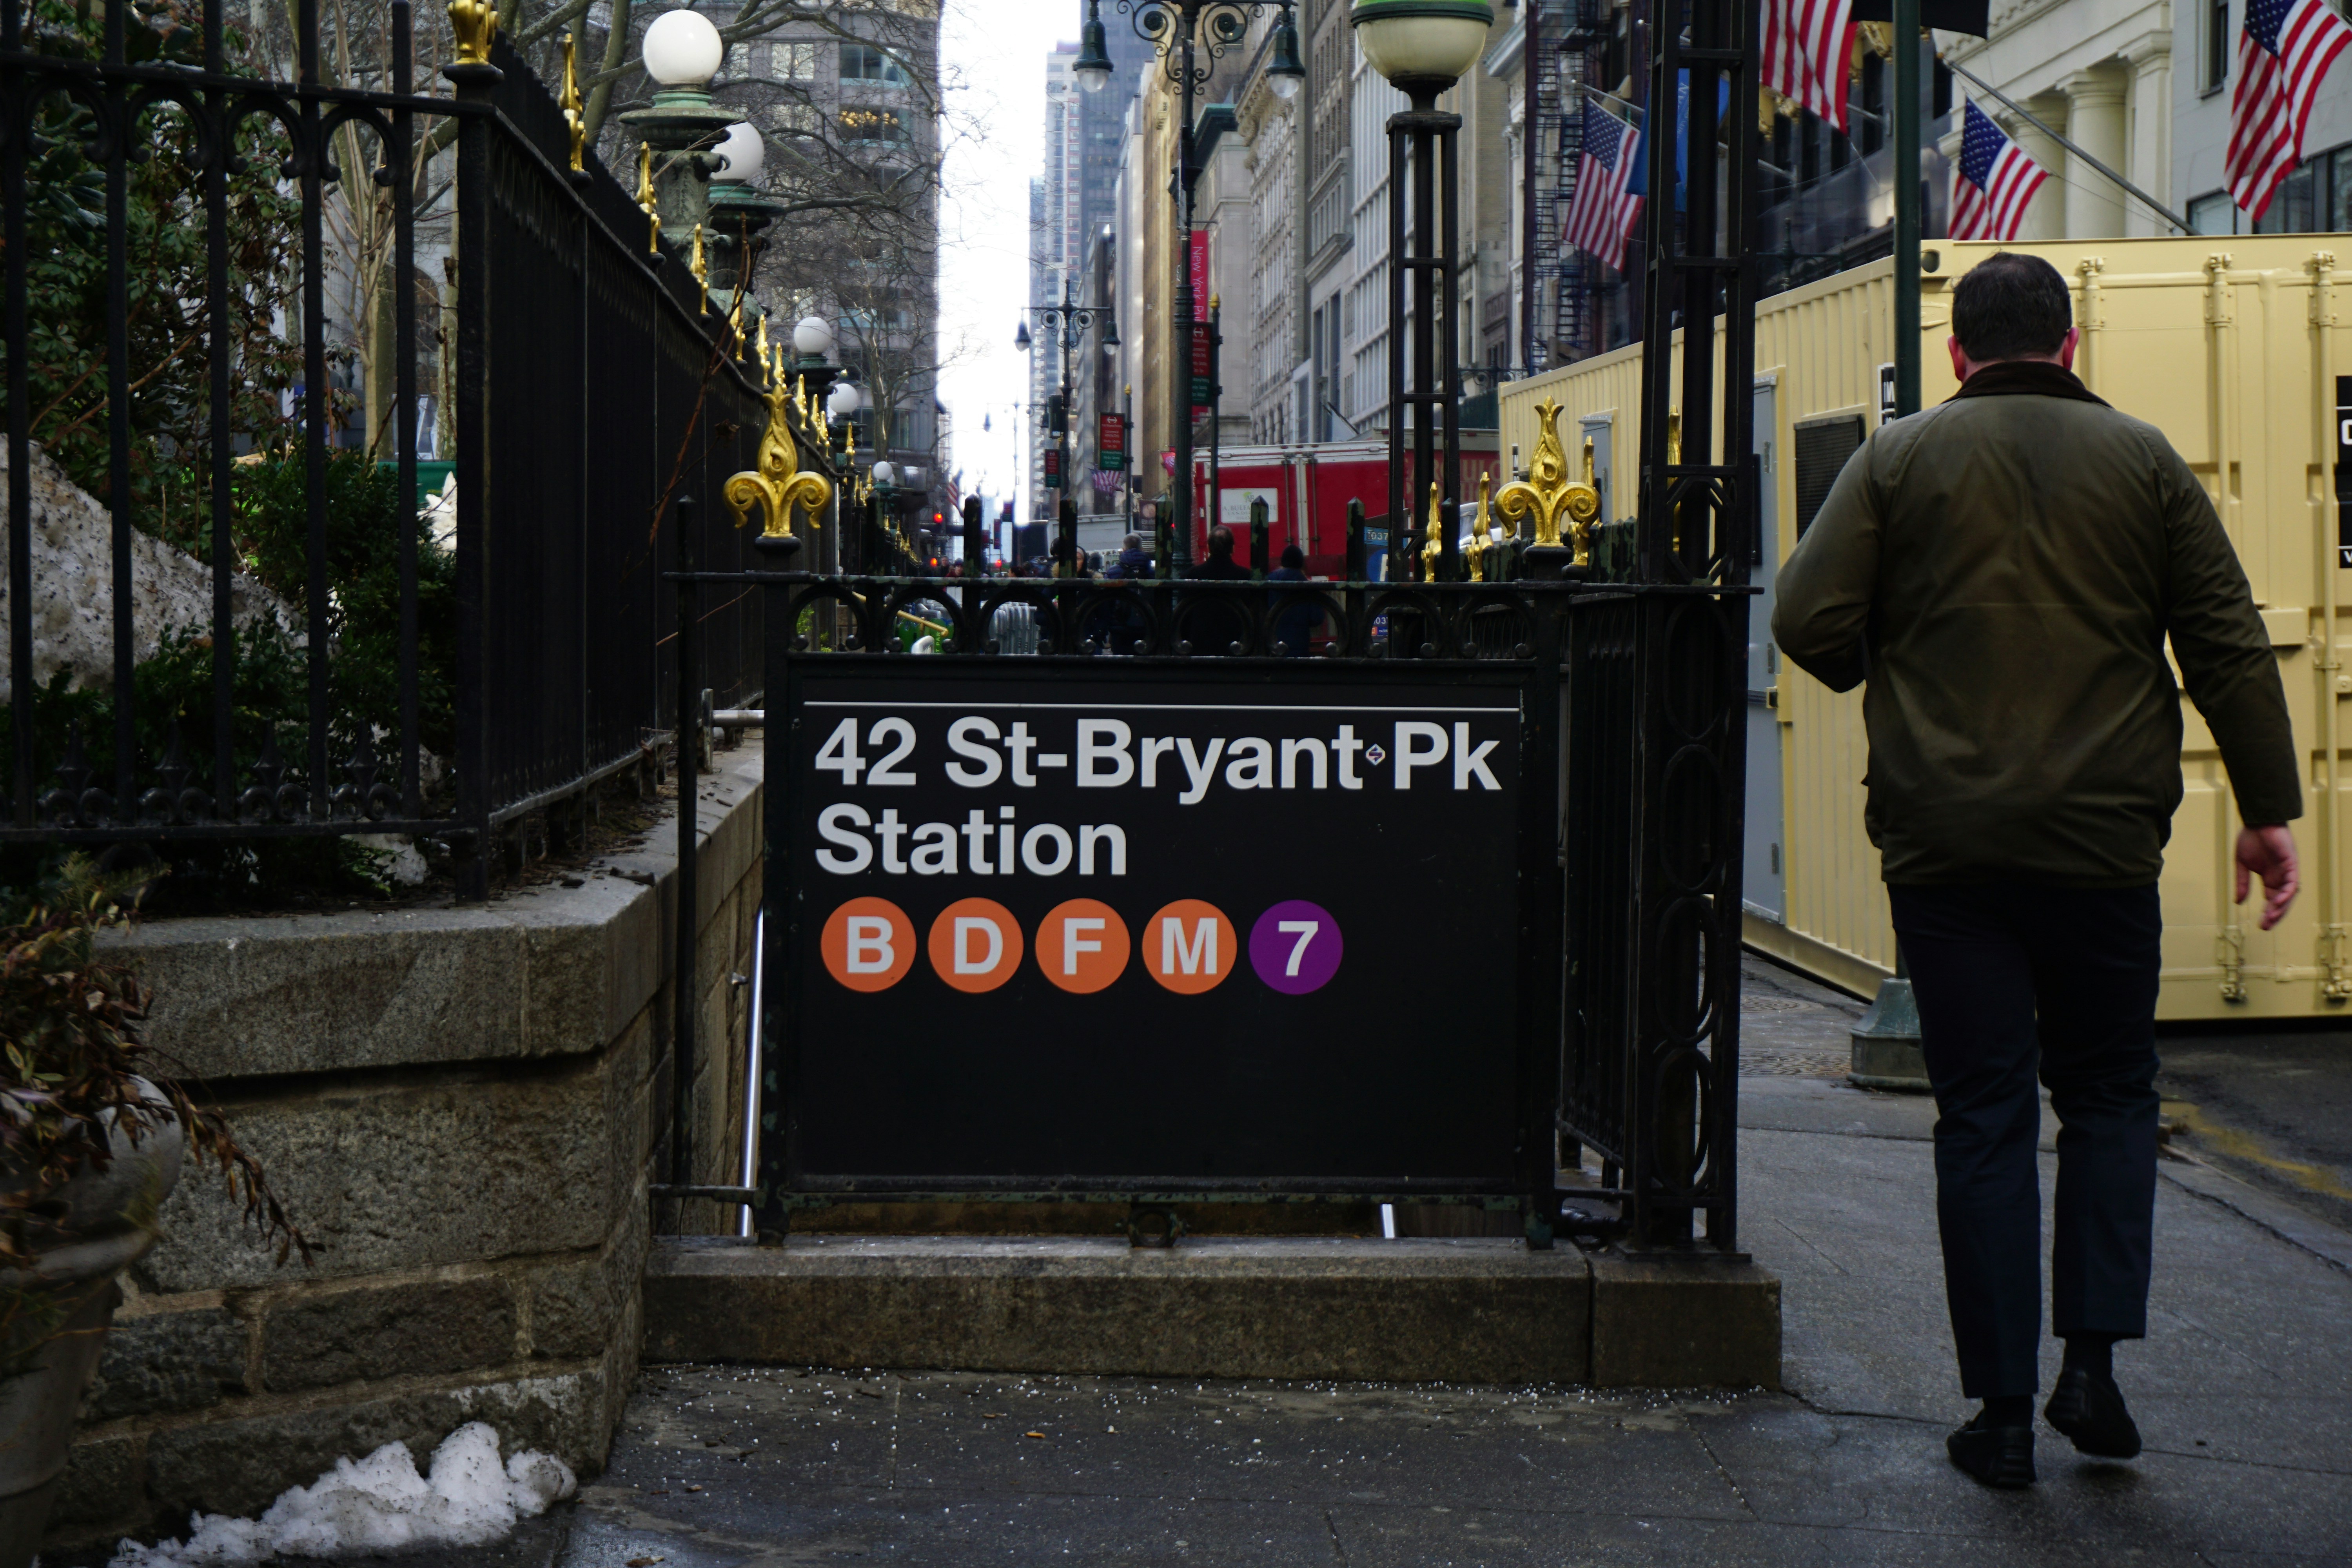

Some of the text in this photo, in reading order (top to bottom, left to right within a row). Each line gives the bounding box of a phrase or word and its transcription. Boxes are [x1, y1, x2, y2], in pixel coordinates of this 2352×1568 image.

[1192, 246, 1203, 272] New
[1193, 276, 1204, 299] York
[815, 716, 1503, 805] 42 St-Bryant Pk
[815, 802, 1127, 876] Station
[846, 915, 1319, 977] B D F M 7
